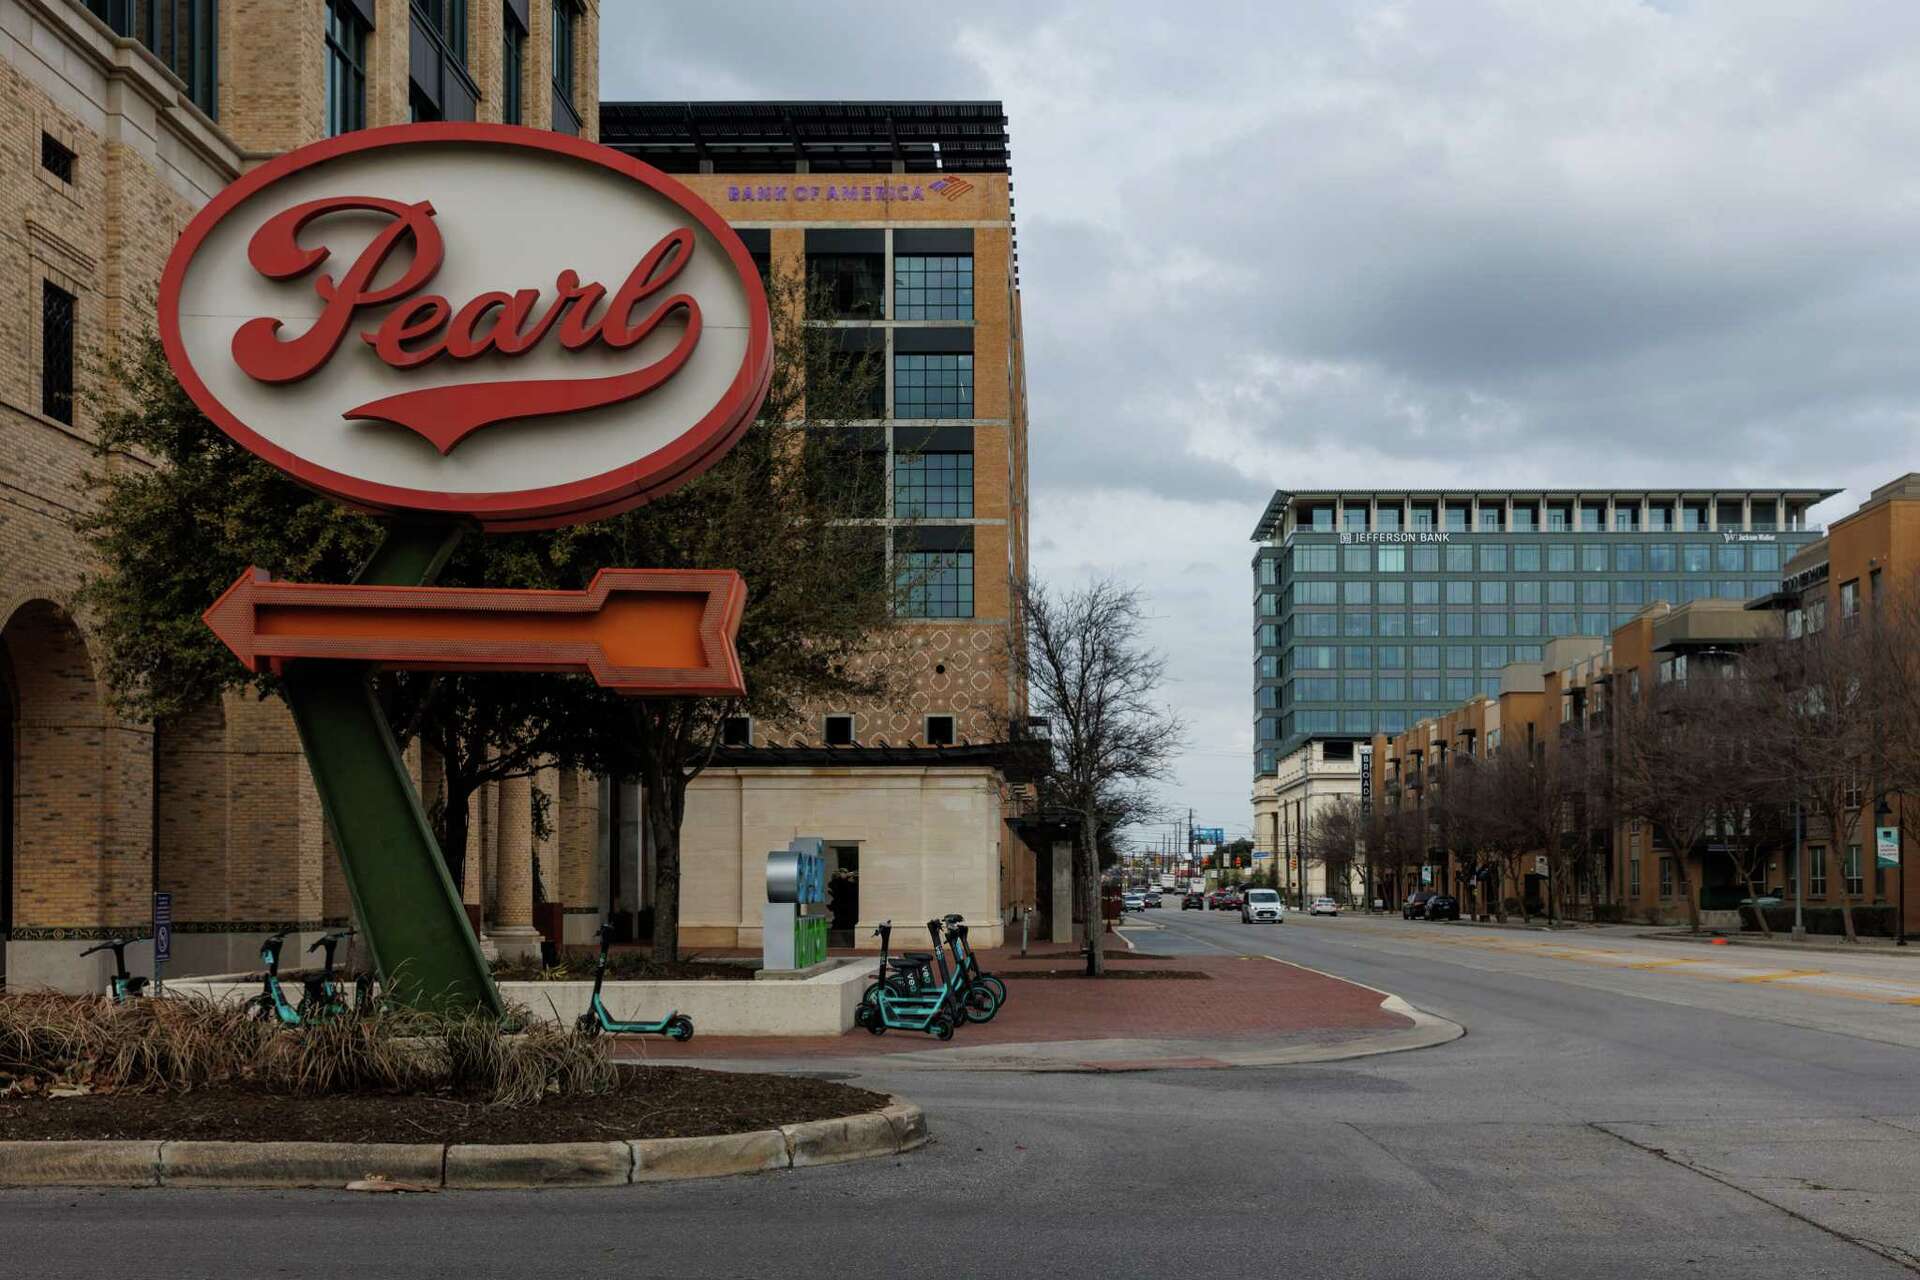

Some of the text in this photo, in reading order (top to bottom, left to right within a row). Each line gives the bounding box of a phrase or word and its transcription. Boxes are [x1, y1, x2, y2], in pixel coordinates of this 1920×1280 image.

[728, 185, 926, 202] BANK OF AMERICA
[231, 196, 702, 384] Pearl
[1355, 533, 1450, 543] JEFFERSON BANK
